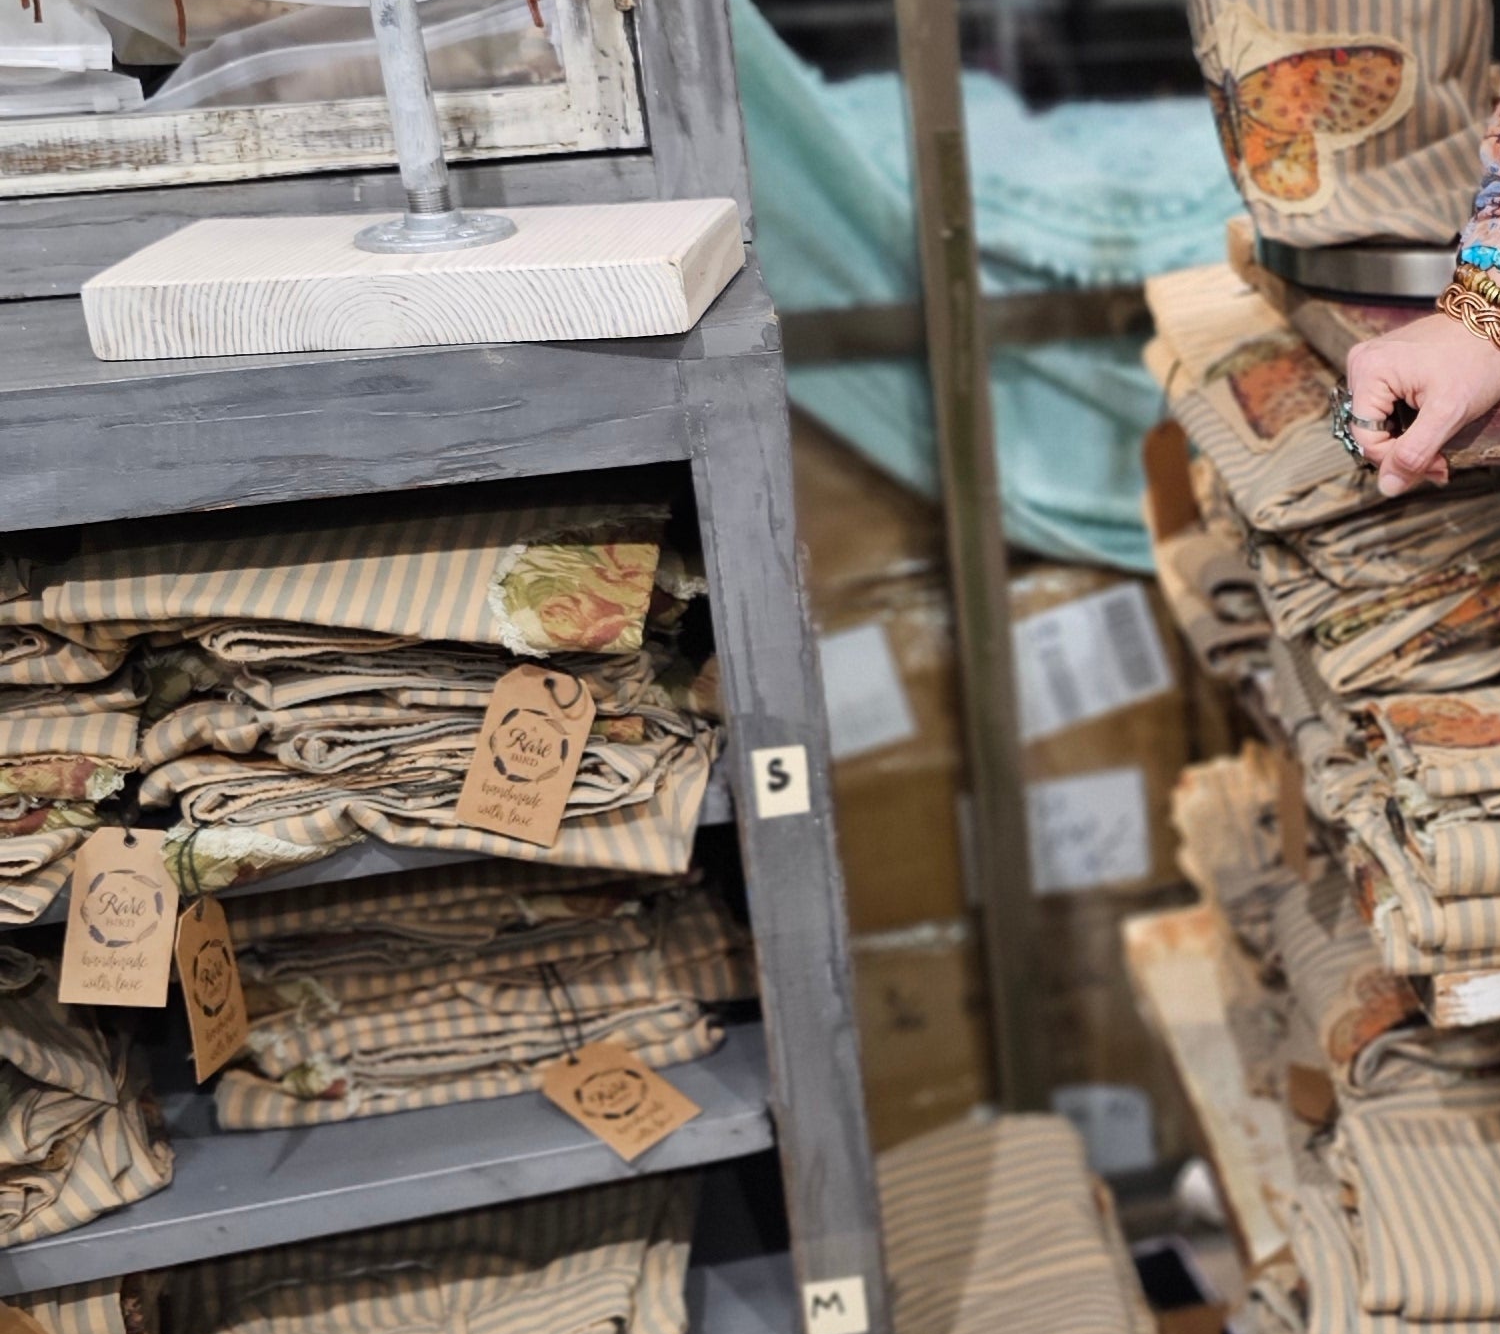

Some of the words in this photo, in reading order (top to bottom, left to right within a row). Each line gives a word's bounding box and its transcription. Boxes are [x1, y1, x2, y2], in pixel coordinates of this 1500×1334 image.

[506, 728, 552, 758] Rare
[766, 757, 791, 793] S
[98, 892, 147, 917] Rare
[811, 1292, 846, 1319] M
